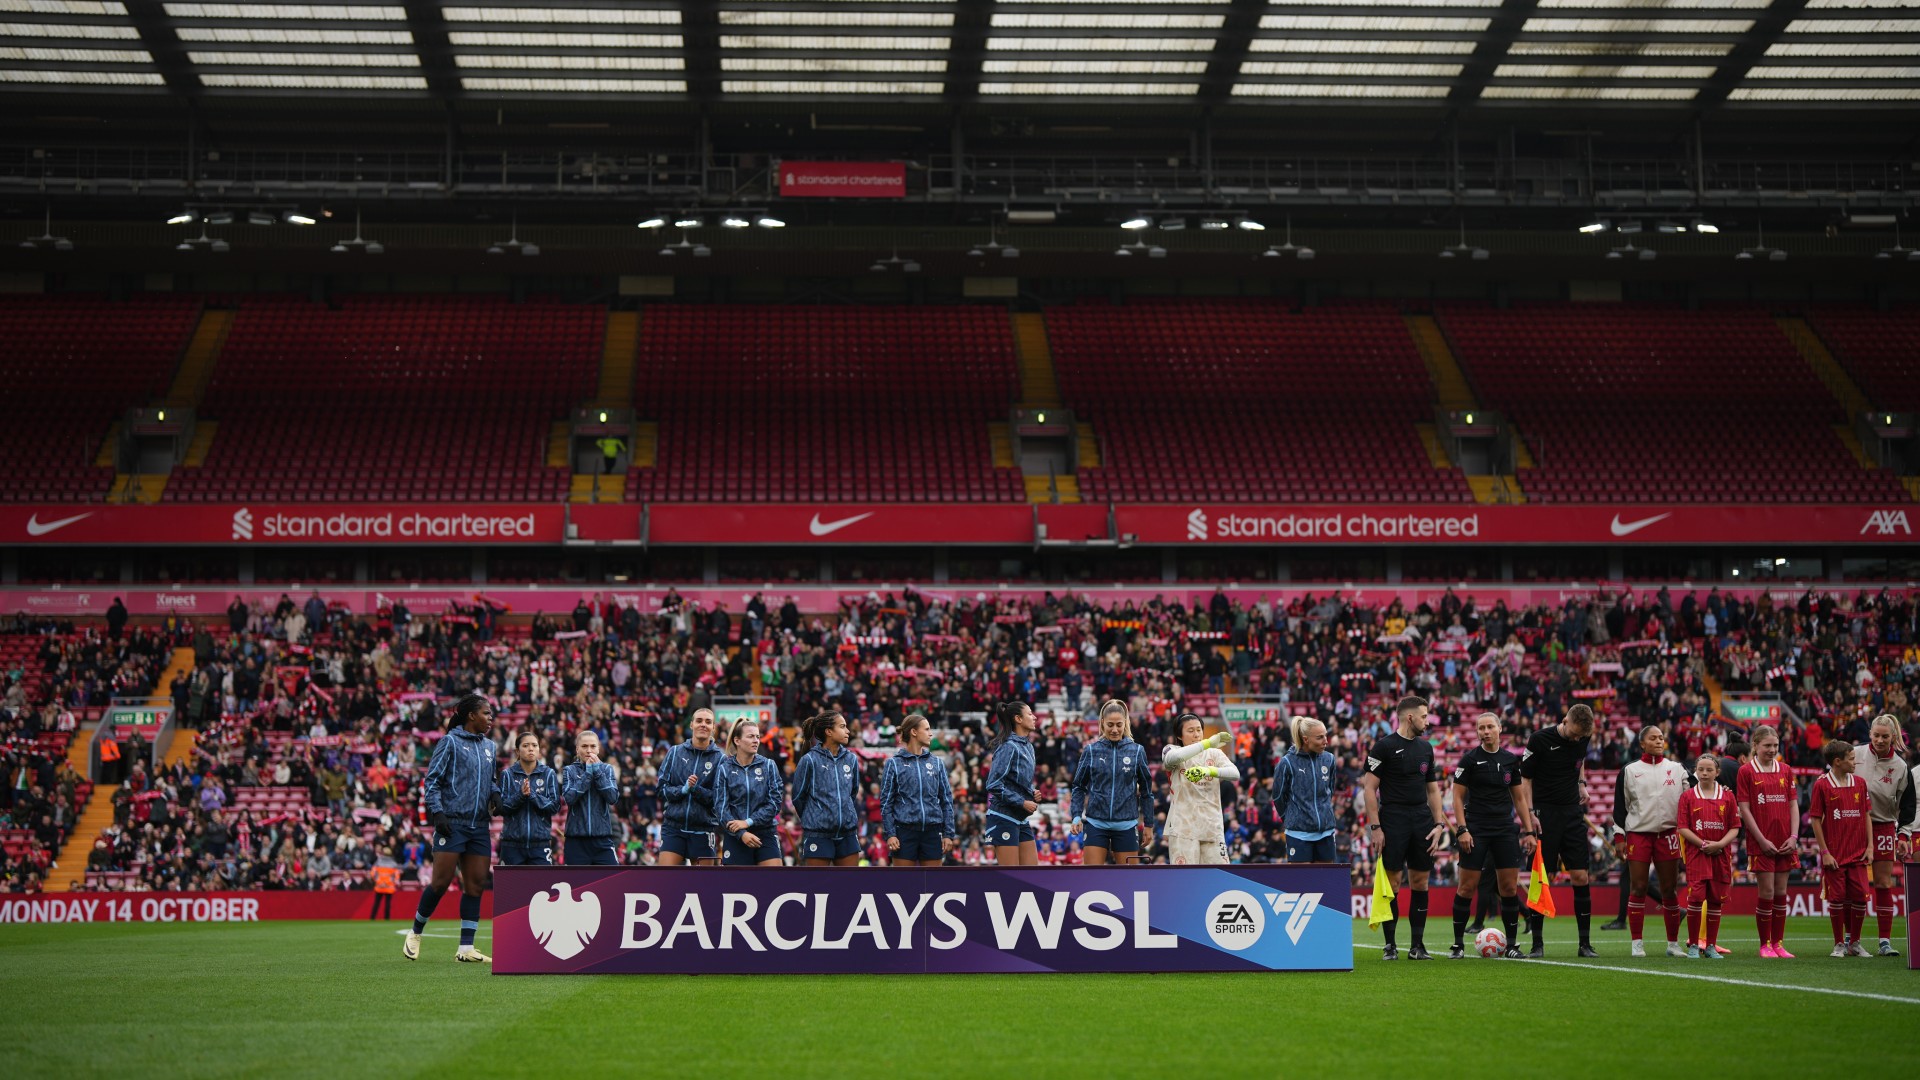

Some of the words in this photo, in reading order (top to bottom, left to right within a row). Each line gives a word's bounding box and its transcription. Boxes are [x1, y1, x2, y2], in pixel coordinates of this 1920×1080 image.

[797, 175, 848, 185] standard
[849, 175, 903, 185] chartered
[263, 513, 391, 536] standard
[399, 513, 535, 536] chartered
[1217, 514, 1342, 536] standard
[1347, 514, 1478, 536] chartered
[1860, 510, 1912, 535] AXA
[115, 714, 134, 723] EXIT
[1665, 834, 1678, 850] 12
[1877, 835, 1893, 850] 23
[106, 899, 132, 922] 14
[141, 898, 259, 922] OCTOBER
[1216, 904, 1254, 923] EA
[619, 892, 967, 951] BARCLAYS
[984, 891, 1178, 950] WSL
[1215, 925, 1255, 933] SPORTS
